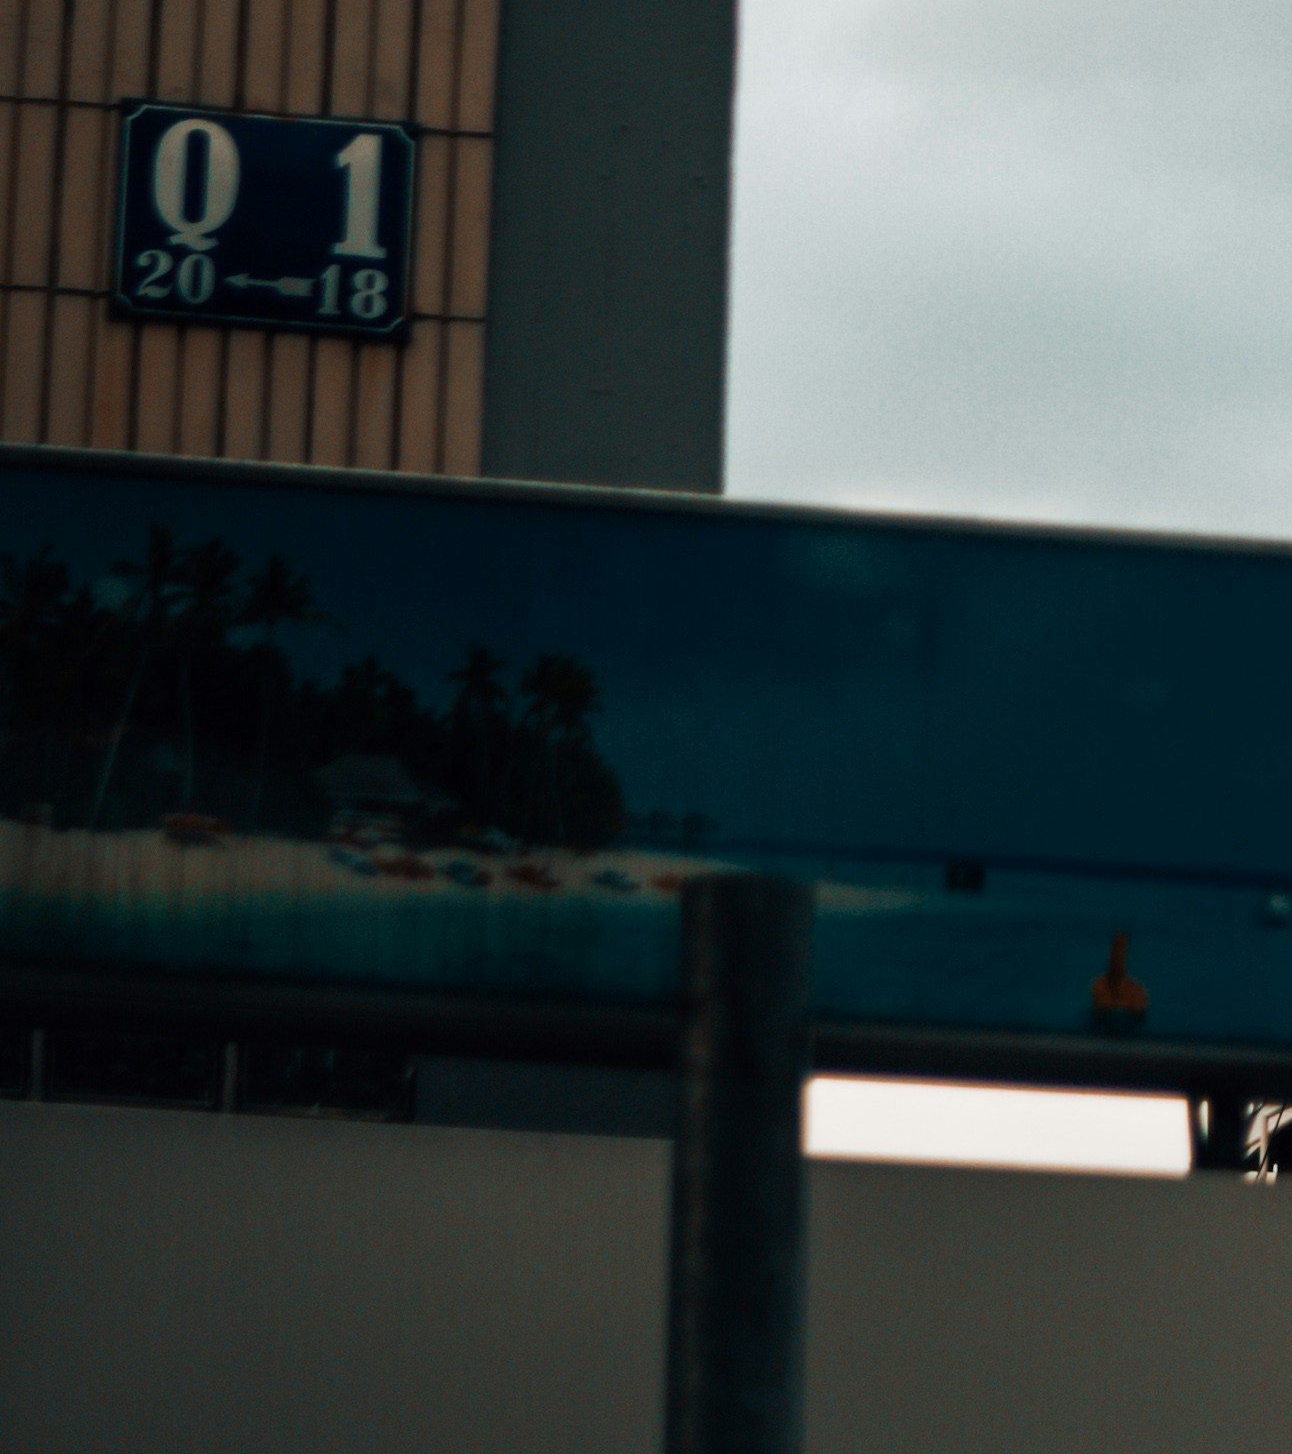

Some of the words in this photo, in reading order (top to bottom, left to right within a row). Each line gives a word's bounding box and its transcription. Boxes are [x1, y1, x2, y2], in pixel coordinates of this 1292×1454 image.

[153, 118, 241, 251] Q
[333, 133, 388, 258] 1
[134, 249, 216, 304] 20
[317, 264, 390, 319] 18
